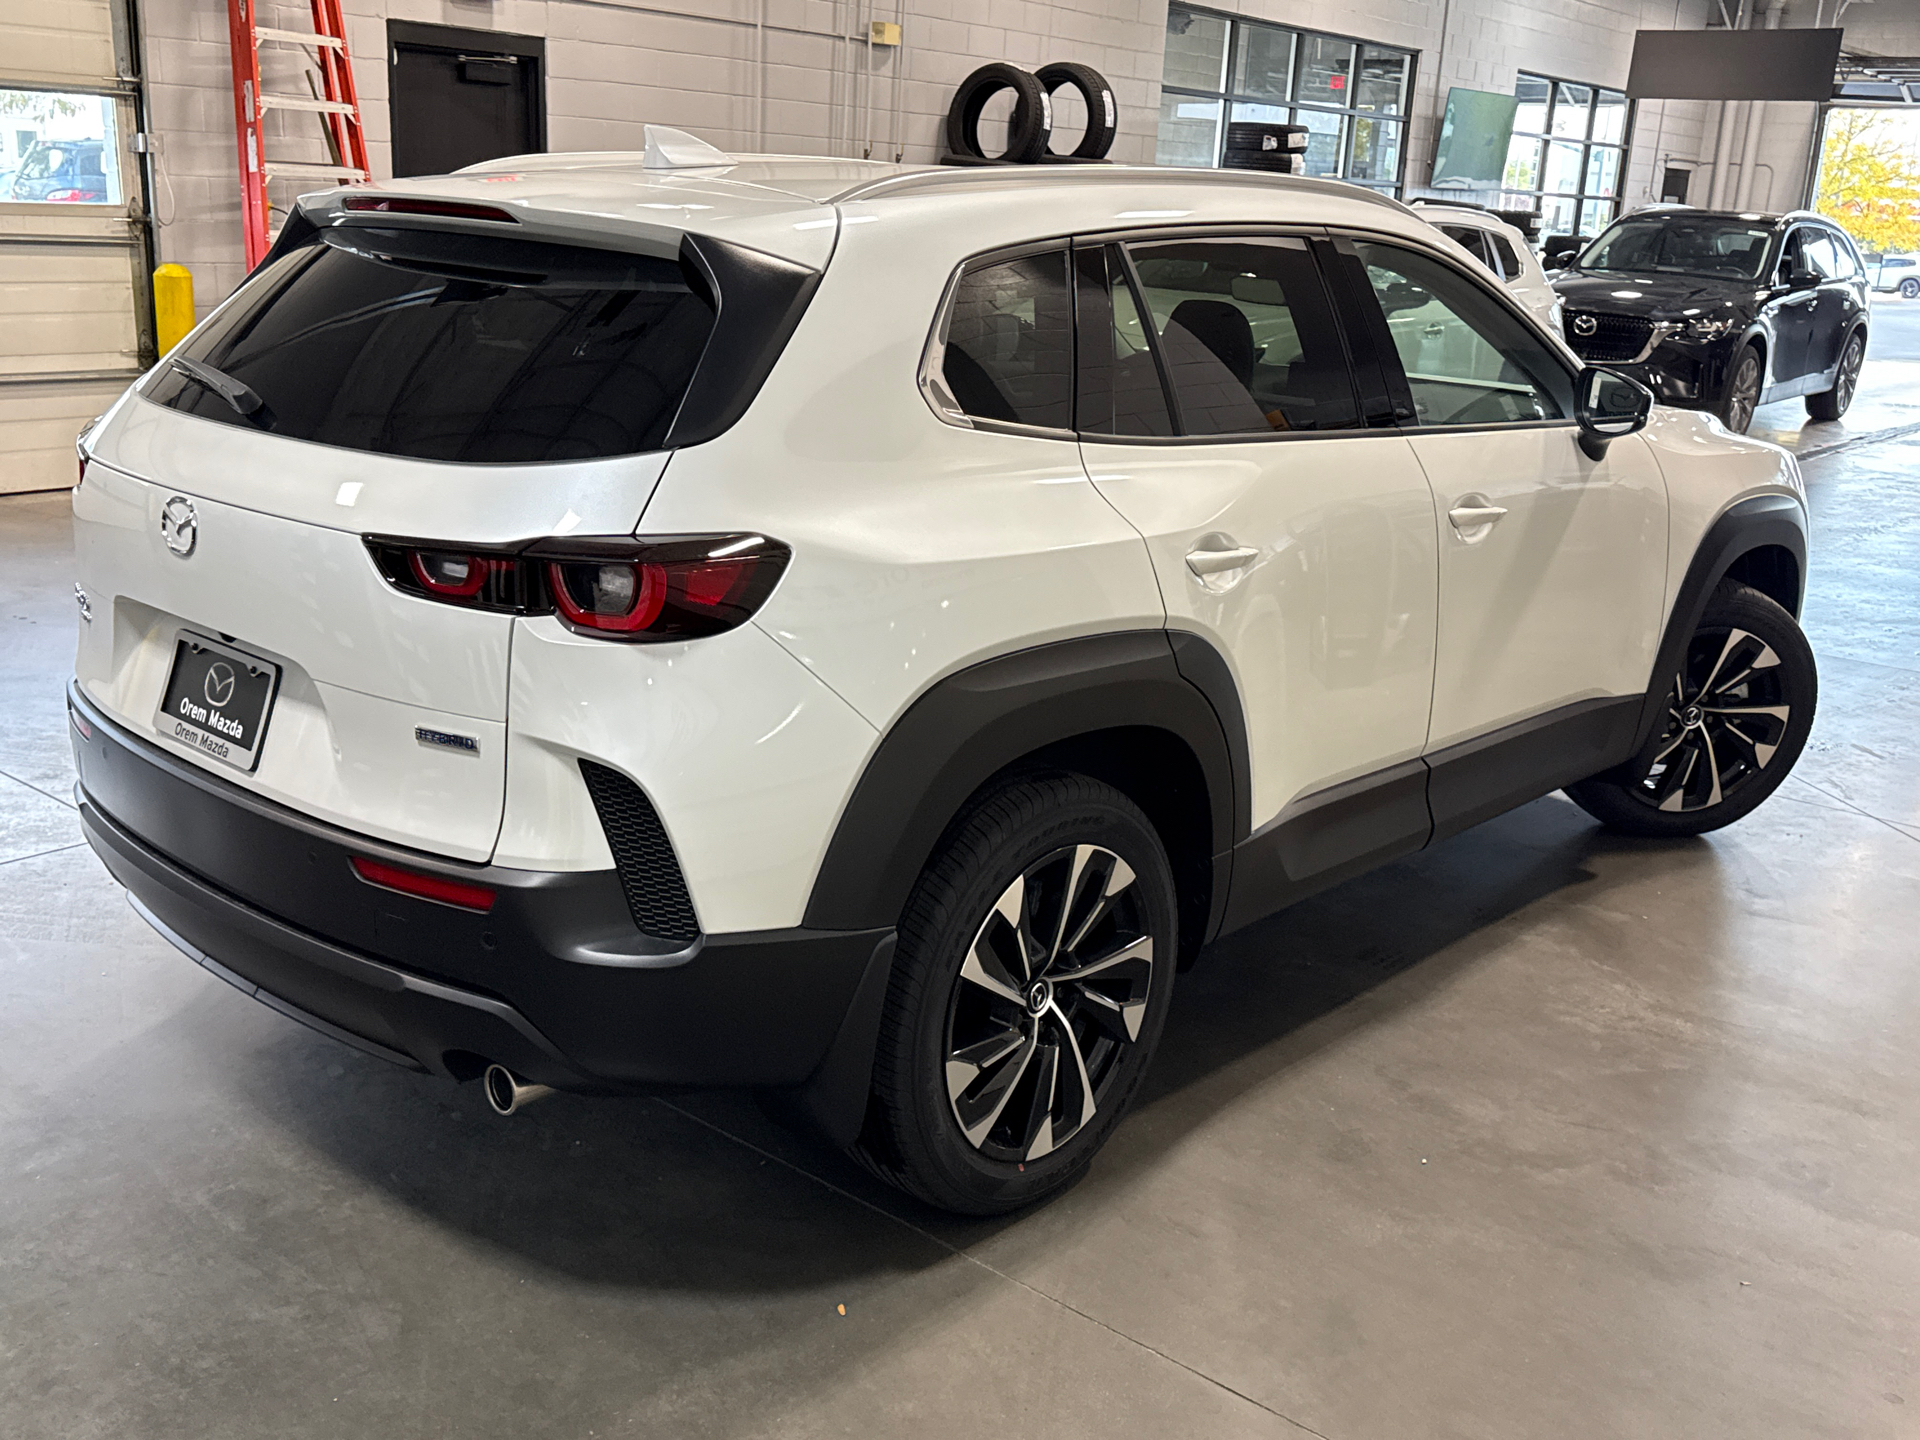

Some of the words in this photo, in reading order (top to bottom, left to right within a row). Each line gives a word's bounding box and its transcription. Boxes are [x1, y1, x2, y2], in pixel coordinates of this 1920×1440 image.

[180, 697, 207, 723] Orem
[208, 709, 244, 739] Mazda
[175, 722, 199, 743] Orem
[199, 734, 230, 758] Mazda
